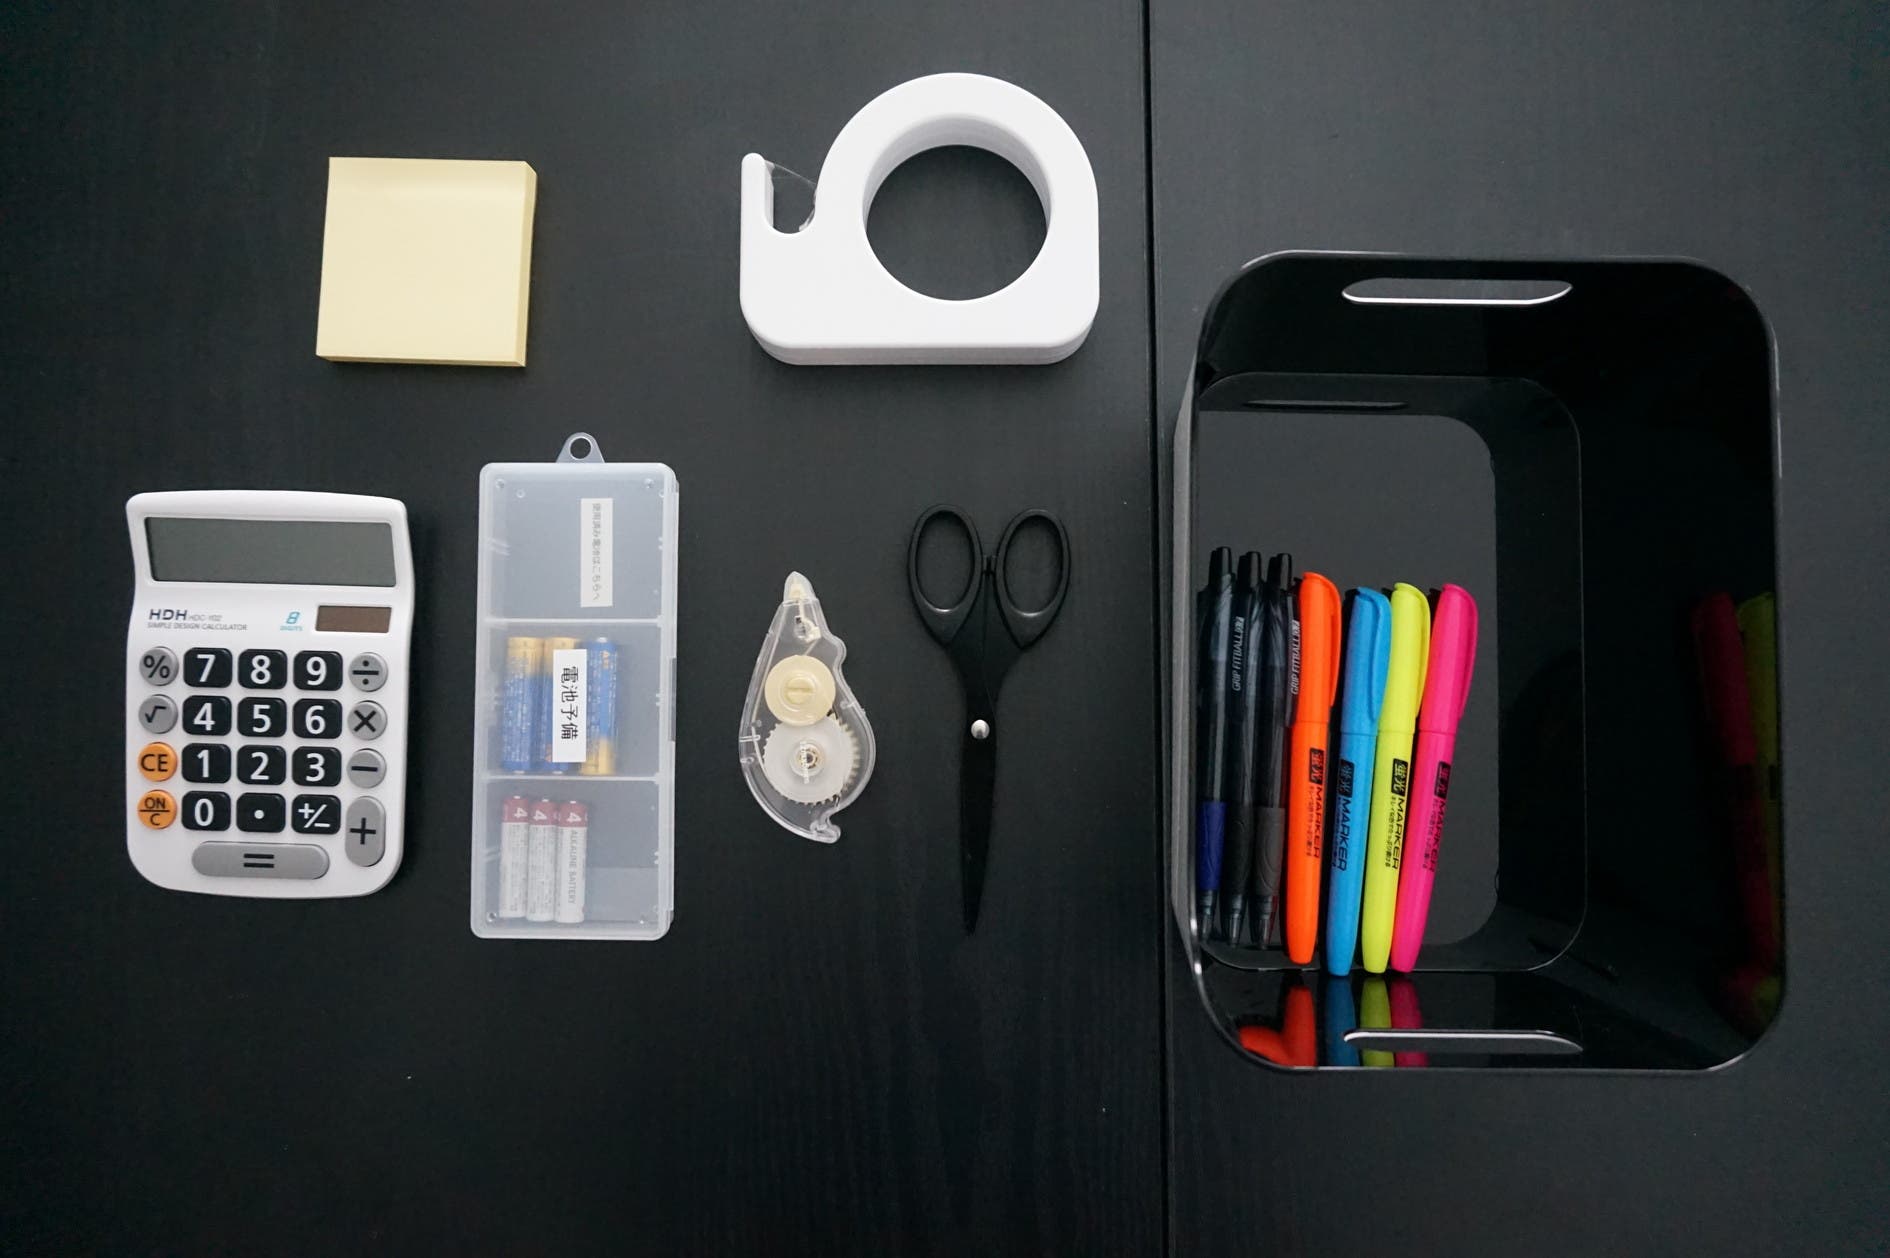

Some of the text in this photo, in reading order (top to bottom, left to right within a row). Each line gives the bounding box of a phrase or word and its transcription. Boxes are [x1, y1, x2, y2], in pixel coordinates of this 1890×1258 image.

[149, 608, 188, 620] HDH
[286, 611, 300, 624] 8
[143, 655, 170, 678] %
[197, 654, 215, 682] 7
[251, 655, 271, 684] 8
[306, 656, 327, 685] 9
[1232, 671, 1241, 691] GRIP
[1290, 674, 1299, 695] GRIP
[194, 703, 215, 731] 4
[561, 665, 578, 741] 電池予備
[253, 704, 271, 732] 5
[305, 705, 326, 734] 6
[140, 753, 168, 772] CE
[197, 750, 209, 778] 1
[251, 751, 269, 780] 2
[305, 752, 326, 781] 3
[144, 797, 166, 809] ON
[195, 799, 214, 827] 0
[514, 808, 527, 819] 4
[533, 810, 547, 821] 4
[1392, 762, 1407, 870] 蛍光 MARKER
[150, 813, 160, 826] C
[566, 812, 582, 823] 4
[1313, 786, 1323, 859] MARKER
[1337, 798, 1351, 871] MARKER
[1429, 799, 1445, 873] MARKER
[568, 830, 578, 905] ALKALINE BATTERY
